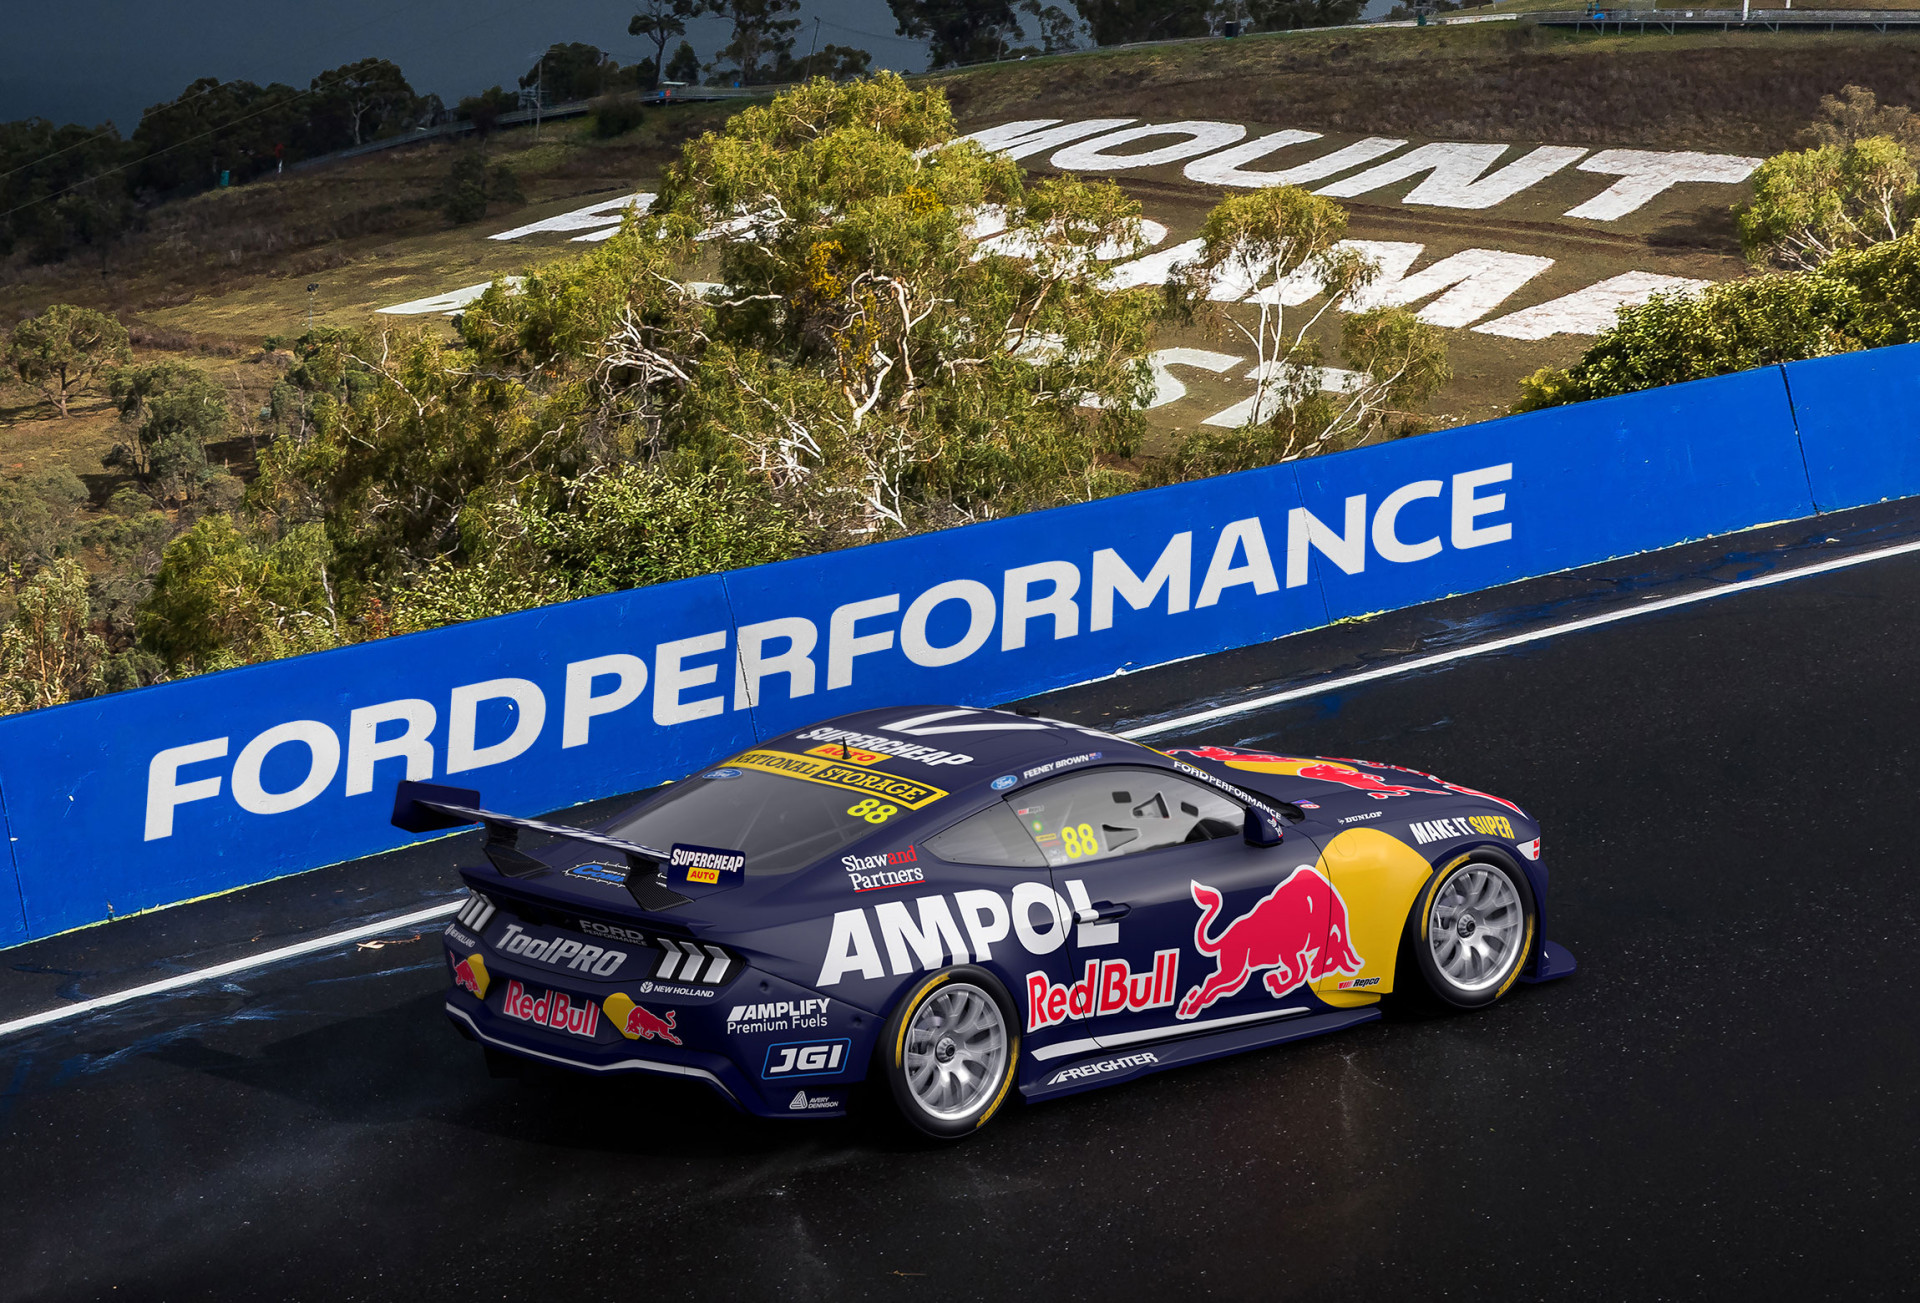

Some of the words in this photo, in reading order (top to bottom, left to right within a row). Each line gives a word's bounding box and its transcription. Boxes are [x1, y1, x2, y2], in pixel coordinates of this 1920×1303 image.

[914, 117, 1765, 221] MOUNT
[144, 677, 546, 841] FORD
[562, 461, 1515, 749] PERFORMANCE
[796, 727, 974, 766] SUPERCHEAP
[816, 746, 877, 762] AUTO
[729, 753, 817, 776] NATIONAL
[819, 766, 928, 801] STORAGE
[1023, 764, 1055, 779] FEENEY
[1055, 755, 1089, 769] BROWN
[847, 798, 898, 824] 88
[1345, 811, 1382, 824] DUNLOP
[1061, 823, 1098, 859] 88
[1409, 818, 1460, 845] MAKE
[1459, 817, 1474, 836] IT
[1468, 815, 1516, 839] SUPER
[671, 848, 744, 873] SUPERCHEAP
[690, 870, 716, 881] AUTO
[848, 867, 924, 891] Partners
[579, 919, 643, 940] FORD
[583, 928, 647, 946] PERFORMANCE
[816, 879, 1120, 987] AMPOL
[654, 985, 672, 994] NEW
[672, 987, 714, 998] HOLLAND
[1353, 977, 1380, 987] Repco
[742, 998, 830, 1020] AMPLIFY
[727, 1018, 788, 1035] Premium
[792, 1014, 828, 1028] Fuels
[769, 1044, 843, 1073] JGI
[808, 1101, 839, 1109] DENNISON
